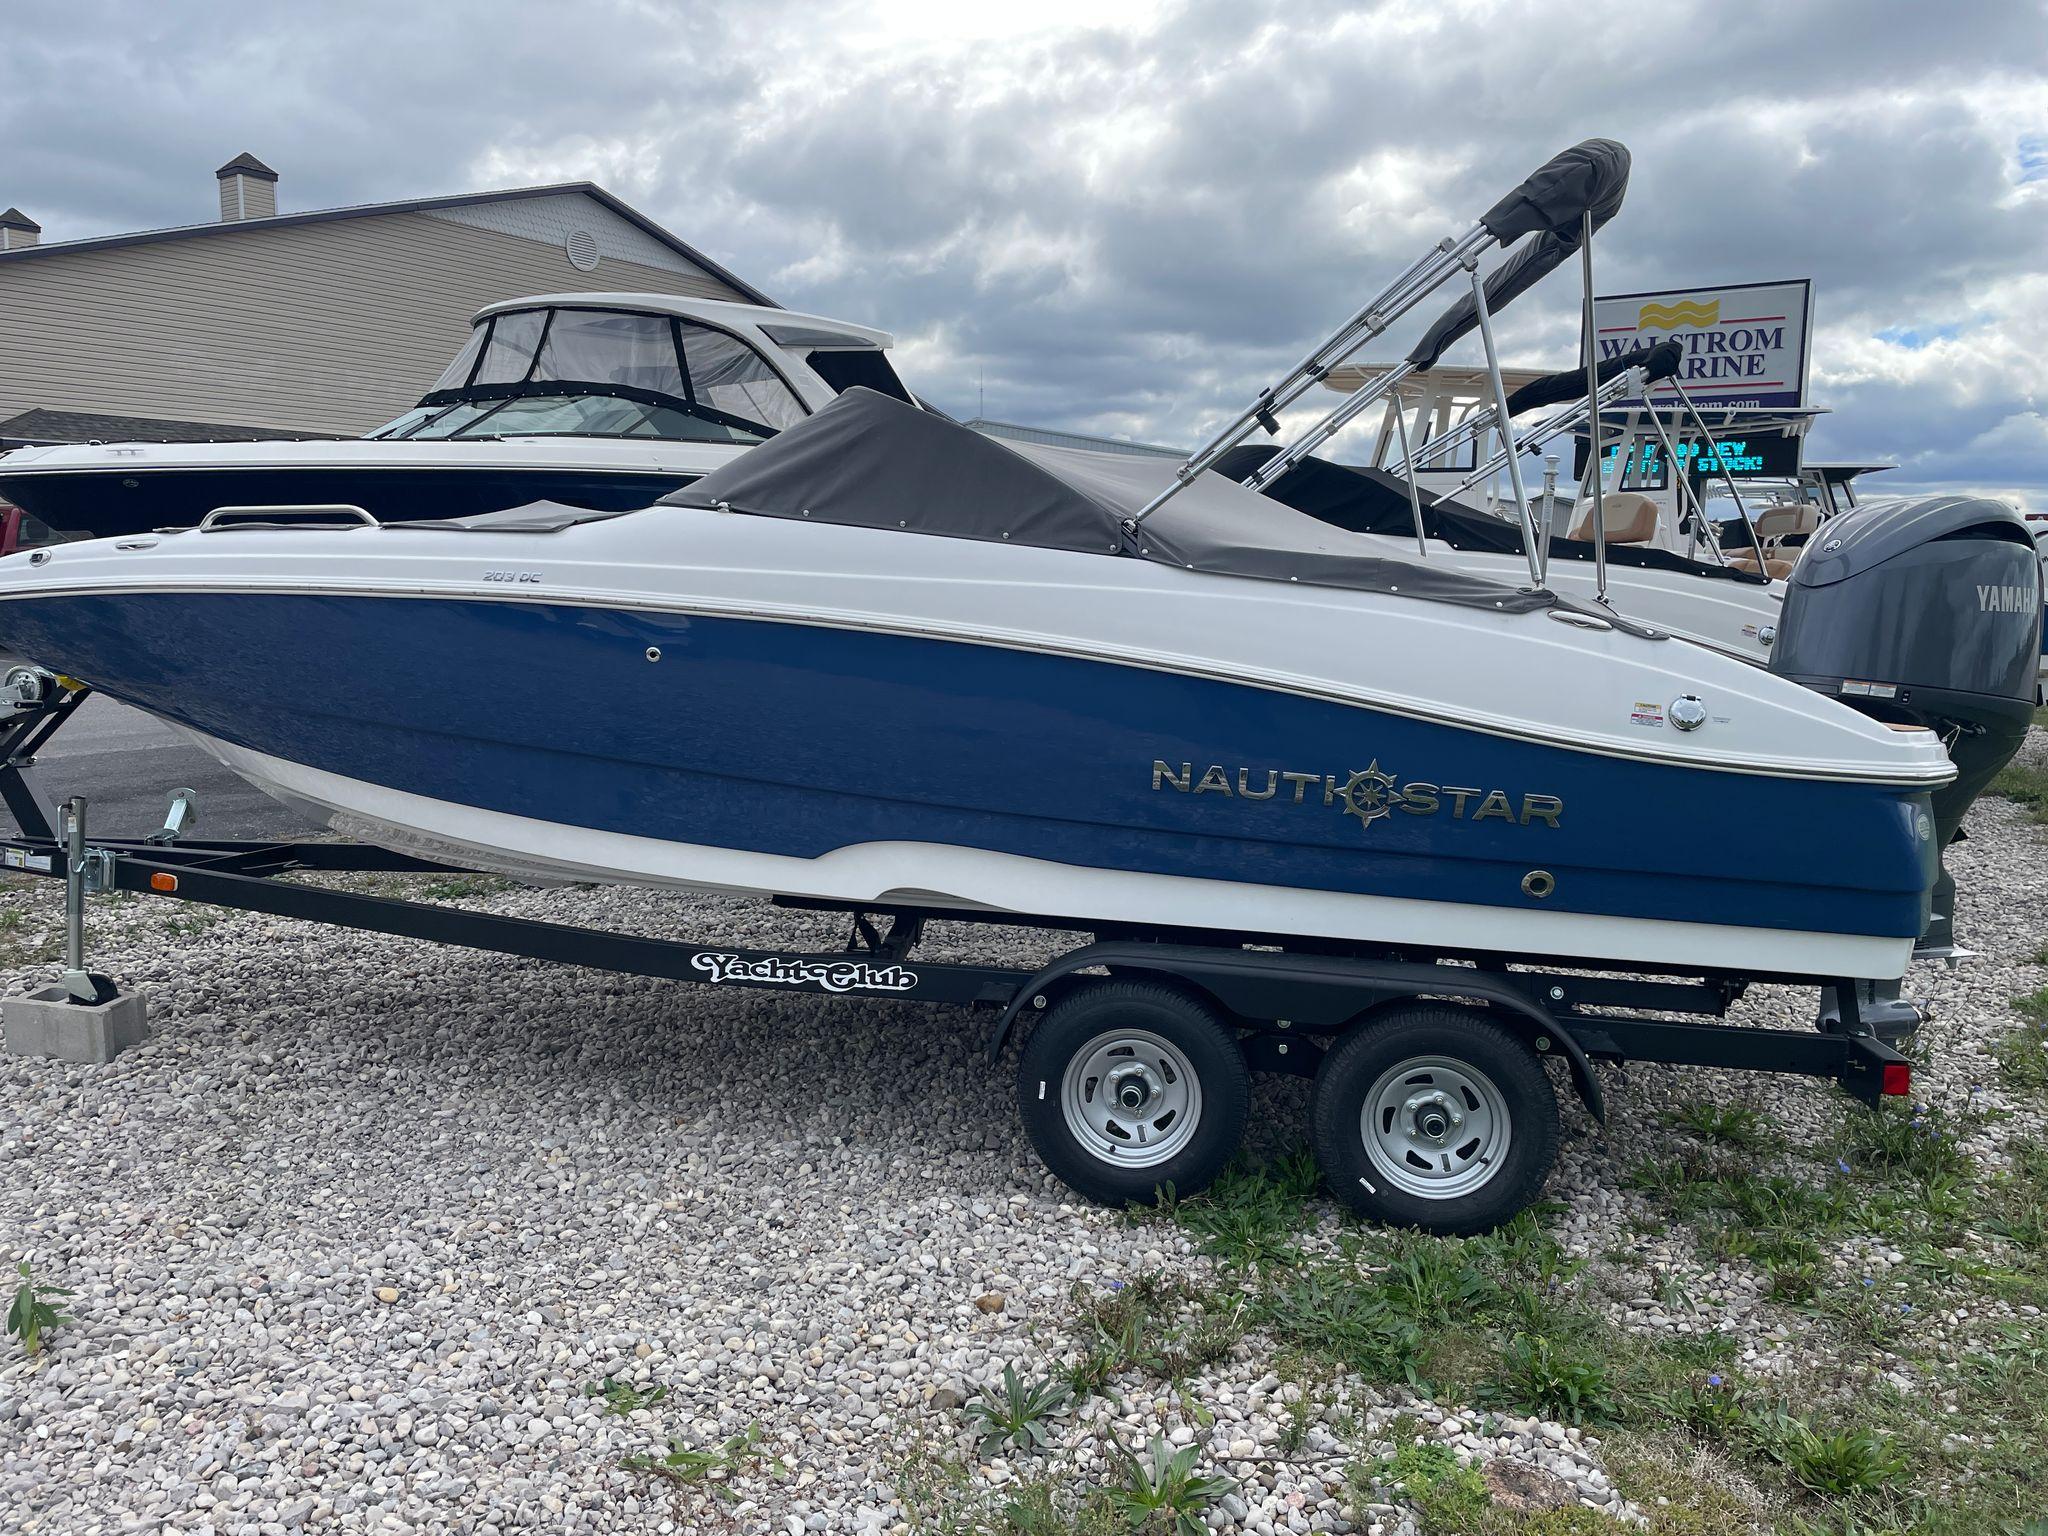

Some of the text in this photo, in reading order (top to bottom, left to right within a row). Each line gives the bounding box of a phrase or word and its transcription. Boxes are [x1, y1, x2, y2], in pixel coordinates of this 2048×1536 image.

[482, 570, 517, 583] 203
[691, 953, 918, 992] Yacht Club
